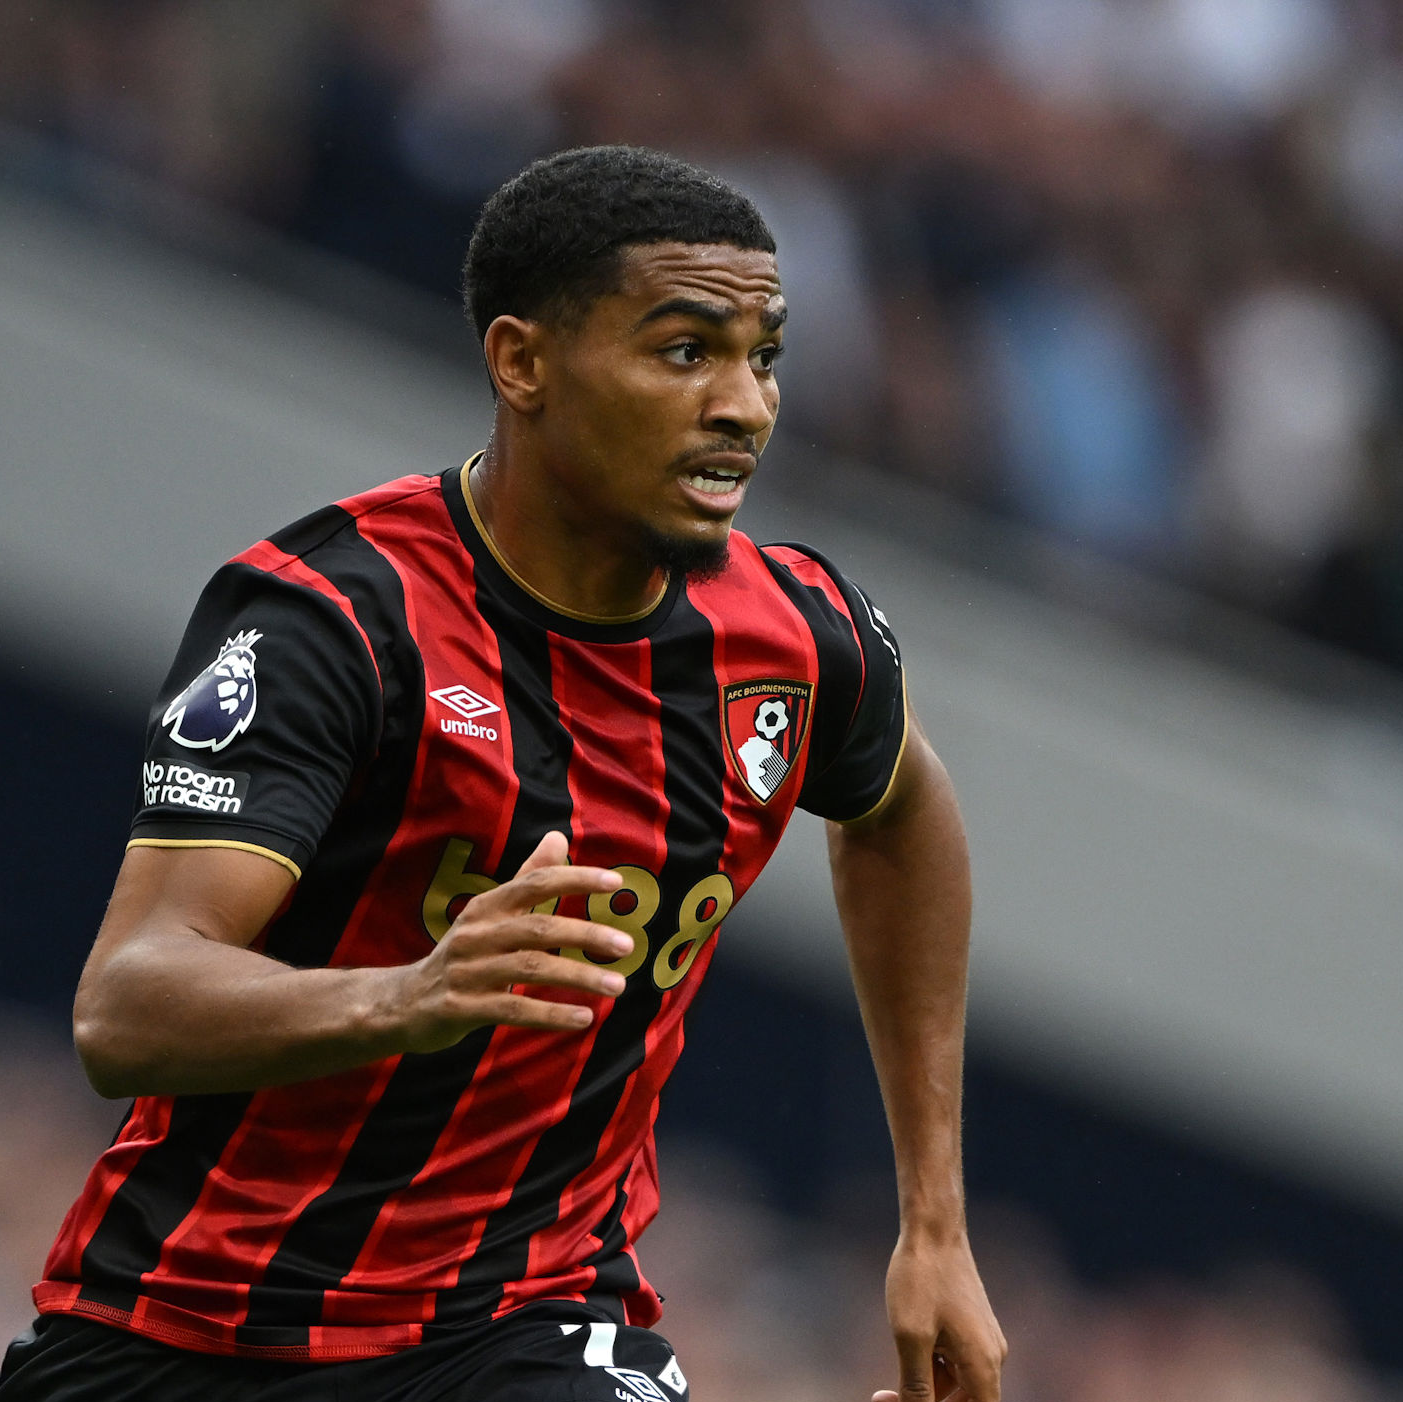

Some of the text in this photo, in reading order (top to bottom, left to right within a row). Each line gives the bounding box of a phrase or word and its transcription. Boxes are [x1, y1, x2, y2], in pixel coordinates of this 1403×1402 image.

[727, 684, 808, 700] AFC BOURNEMOUTH
[440, 718, 498, 742] umbro
[142, 760, 235, 796] No room
[160, 784, 242, 814] racism
[422, 837, 734, 991] b88
